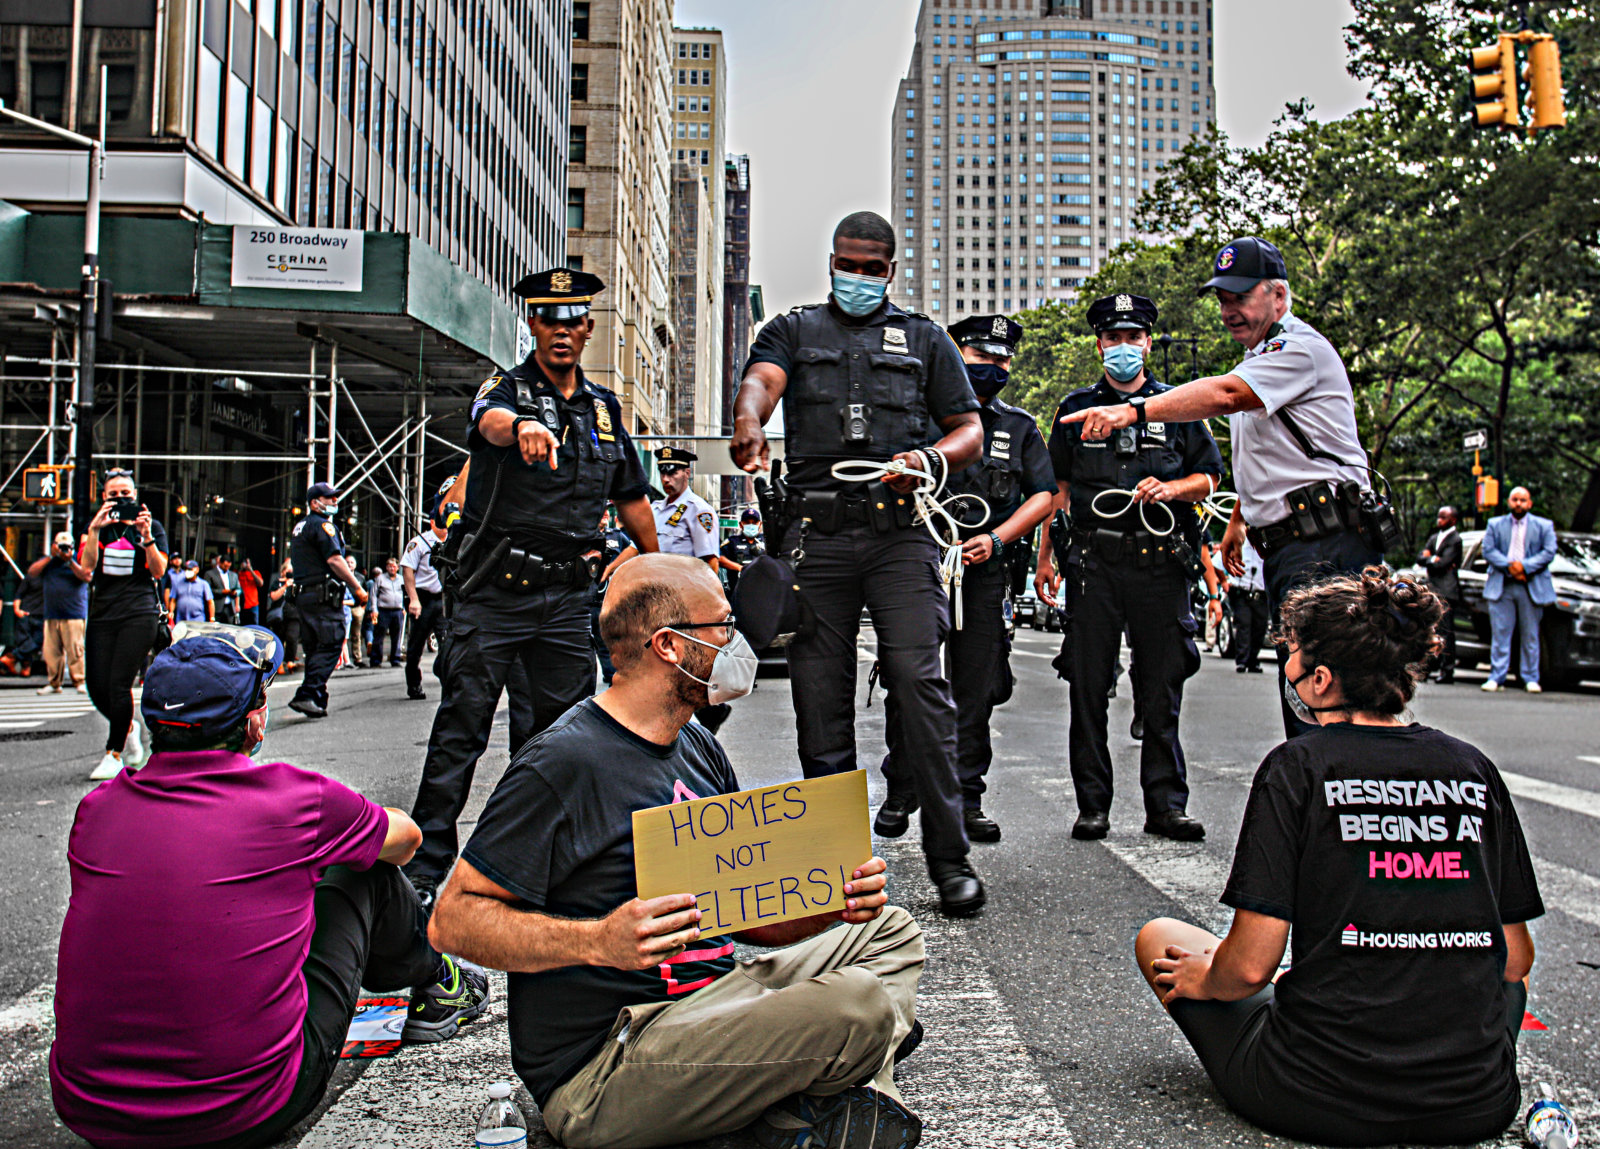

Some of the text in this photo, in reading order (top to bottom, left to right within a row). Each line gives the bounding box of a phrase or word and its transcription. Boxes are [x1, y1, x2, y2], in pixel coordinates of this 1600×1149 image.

[250, 231, 348, 249] 250 Broadway
[267, 253, 327, 265] CERINA
[1324, 779, 1487, 810] RESISTANCE
[669, 786, 806, 846] HOMES
[1339, 814, 1482, 843] BEGINS AT
[715, 840, 771, 873] NOT
[1368, 851, 1470, 879] HOME.
[693, 864, 848, 933] ELTERS!
[1359, 931, 1493, 949] HOUSING WORKS
